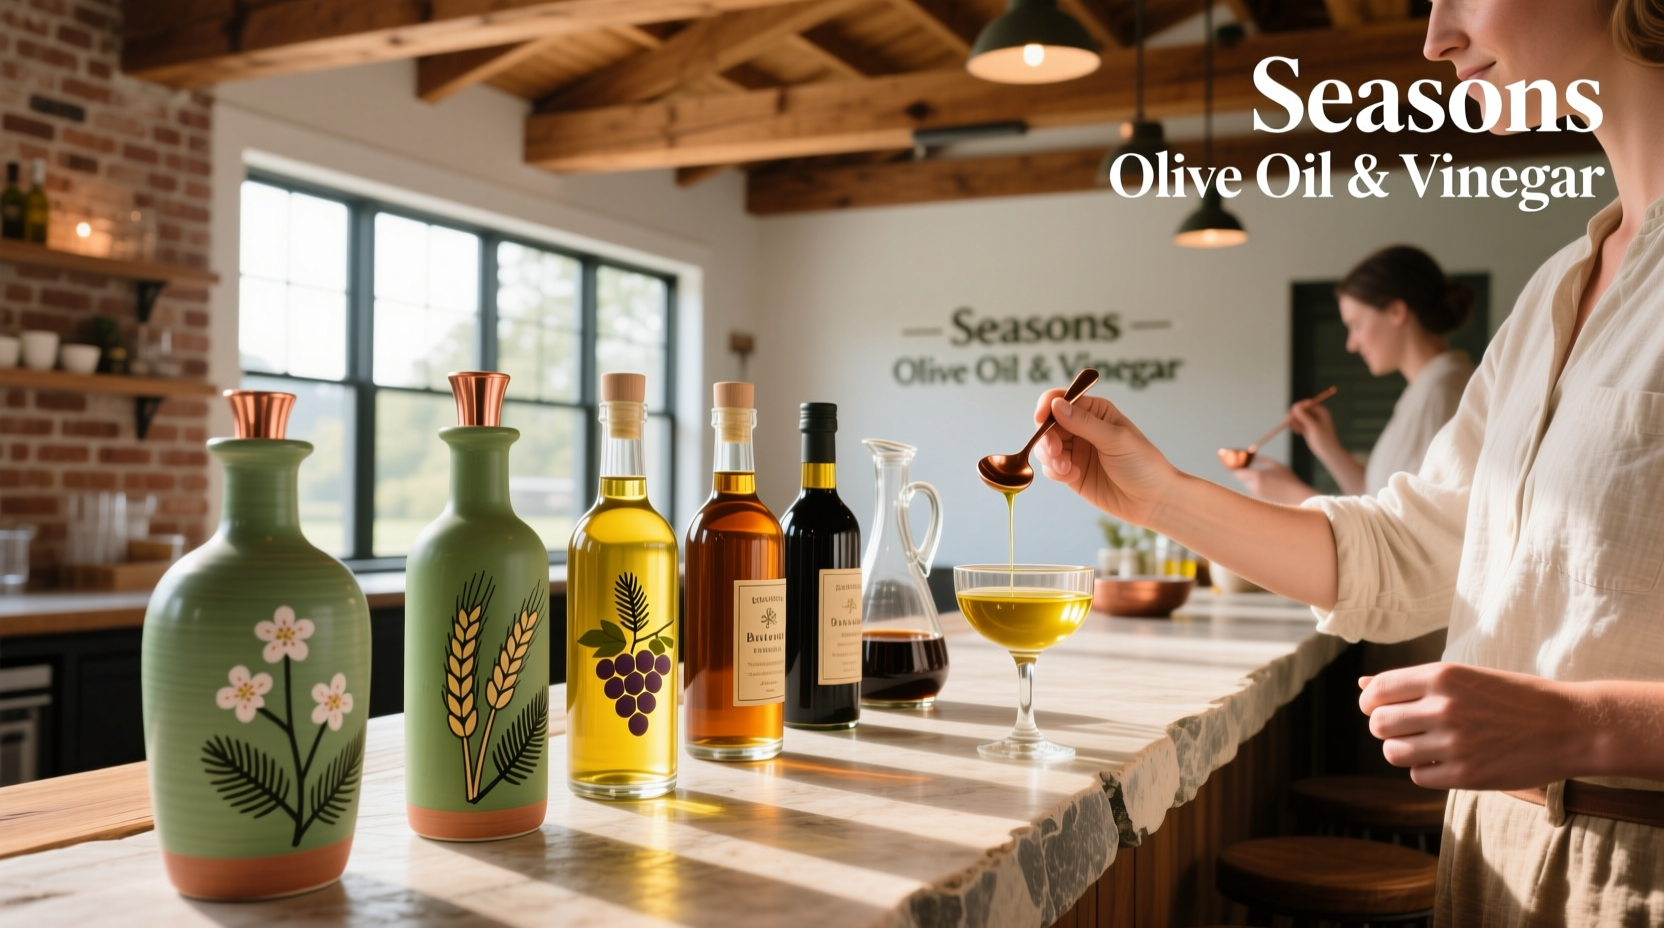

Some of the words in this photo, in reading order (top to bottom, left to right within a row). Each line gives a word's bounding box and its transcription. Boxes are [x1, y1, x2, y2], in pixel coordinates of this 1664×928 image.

[950, 307, 1122, 346] Seasons
[893, 356, 969, 386] Olive
[975, 354, 1019, 384] Oil
[1028, 355, 1052, 383] &
